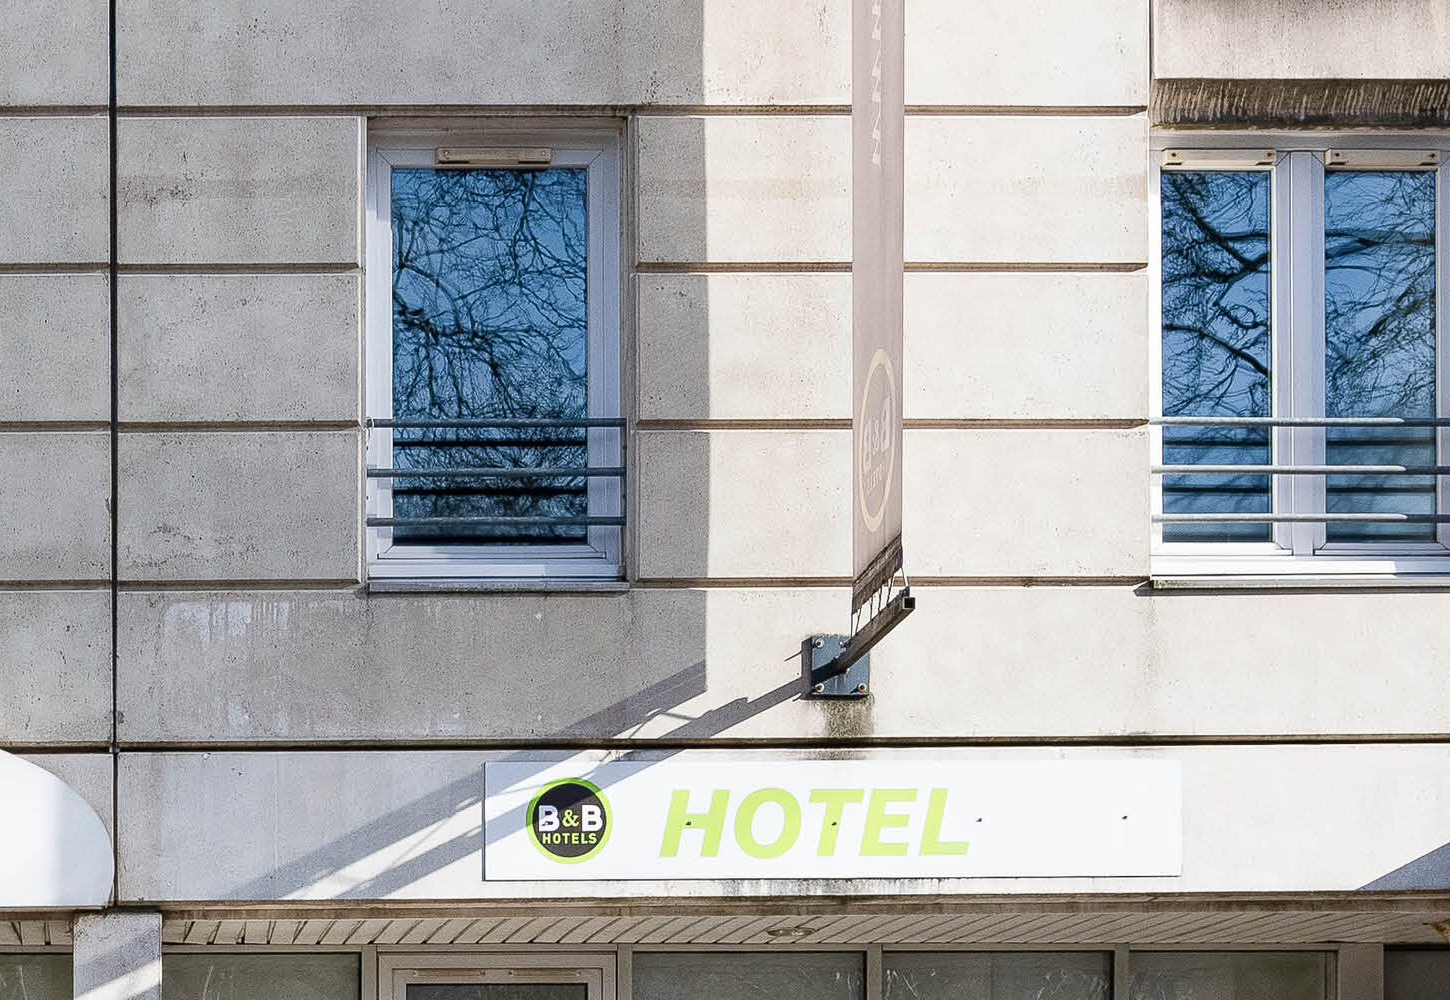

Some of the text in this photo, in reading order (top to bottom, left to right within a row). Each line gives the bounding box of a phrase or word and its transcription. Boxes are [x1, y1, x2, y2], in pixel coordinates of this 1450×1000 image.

[538, 804, 604, 832] B&B
[659, 787, 971, 859] HOTEL
[542, 832, 598, 845] HOTELS
